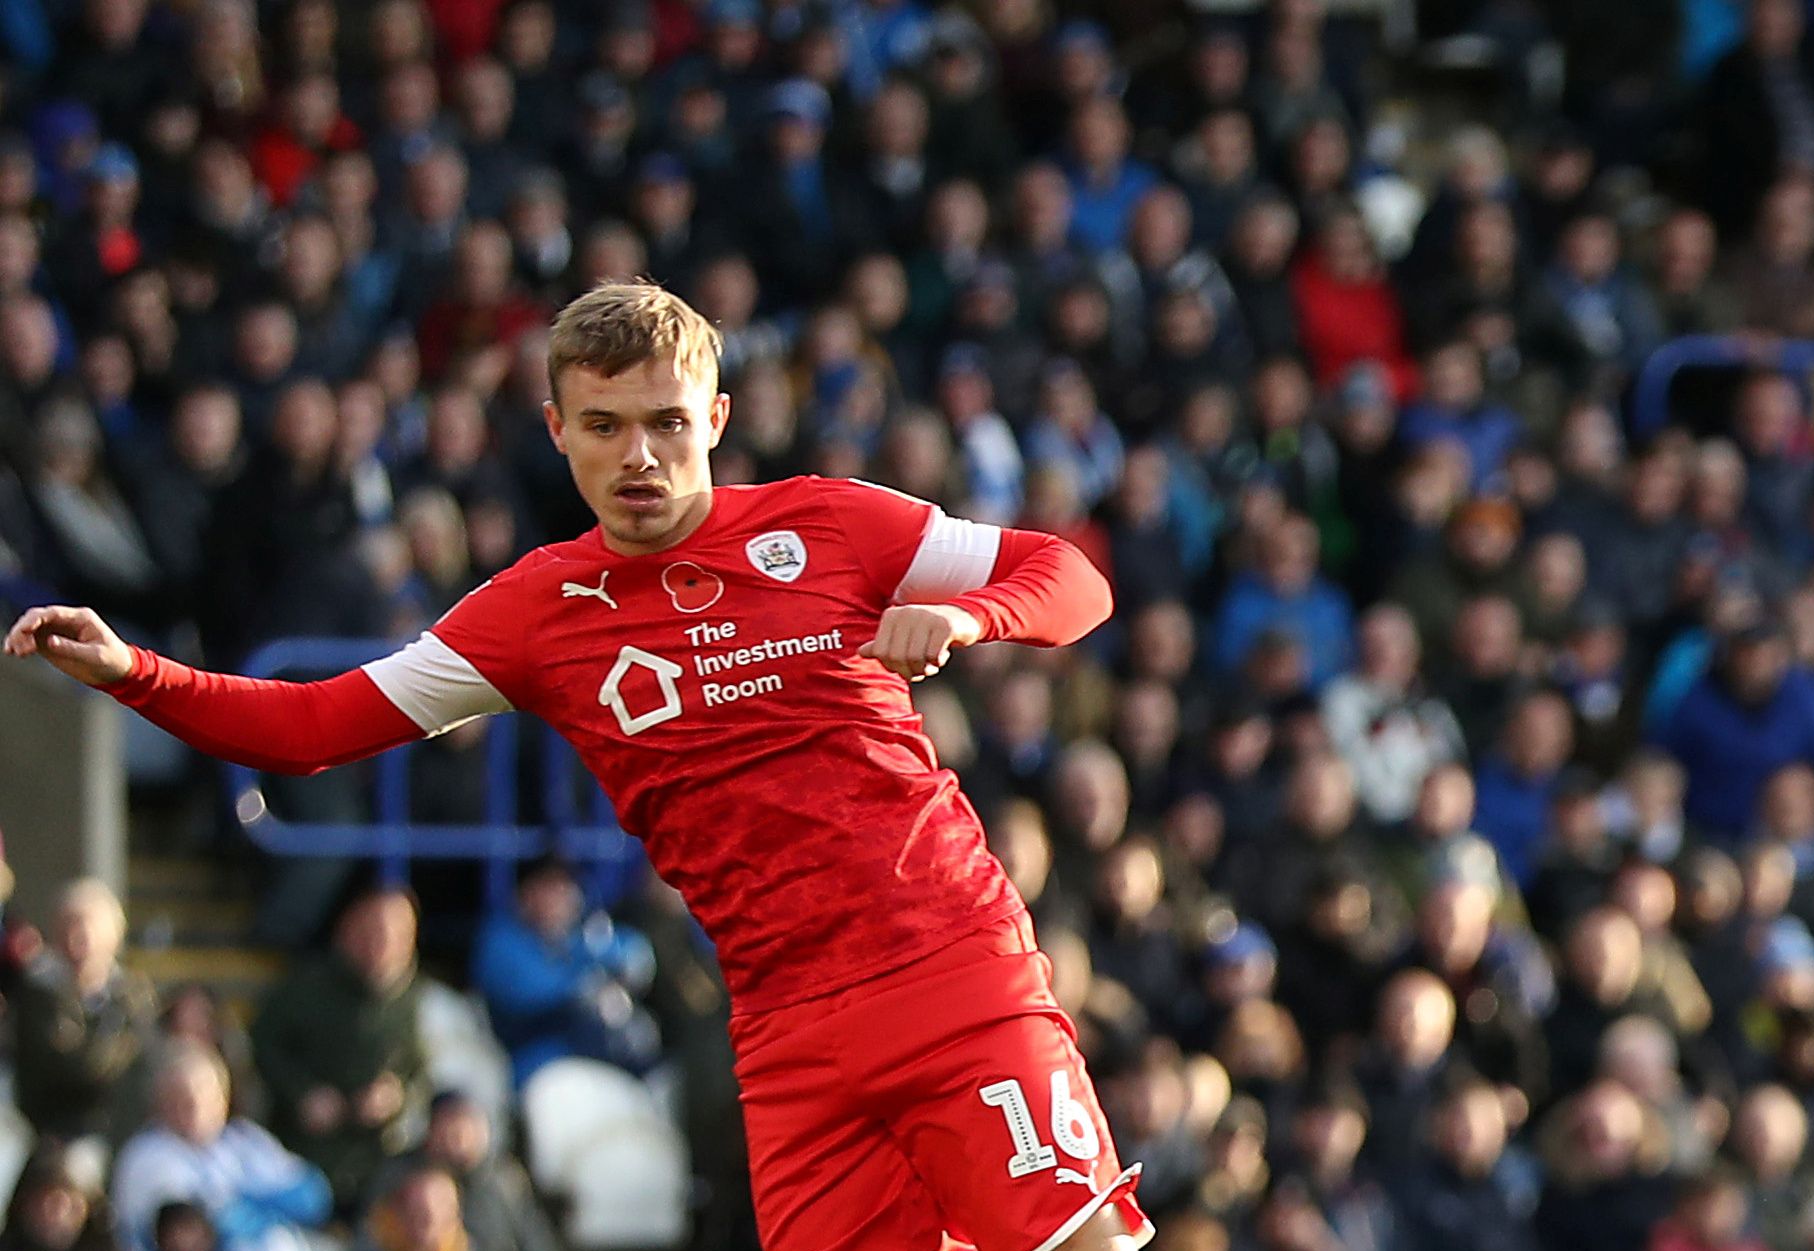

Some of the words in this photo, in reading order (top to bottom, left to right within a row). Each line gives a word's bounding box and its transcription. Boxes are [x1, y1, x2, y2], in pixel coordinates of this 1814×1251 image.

[684, 621, 736, 647] The
[693, 629, 843, 676] Investment
[702, 674, 783, 707] Room
[979, 1069, 1101, 1179] 16
